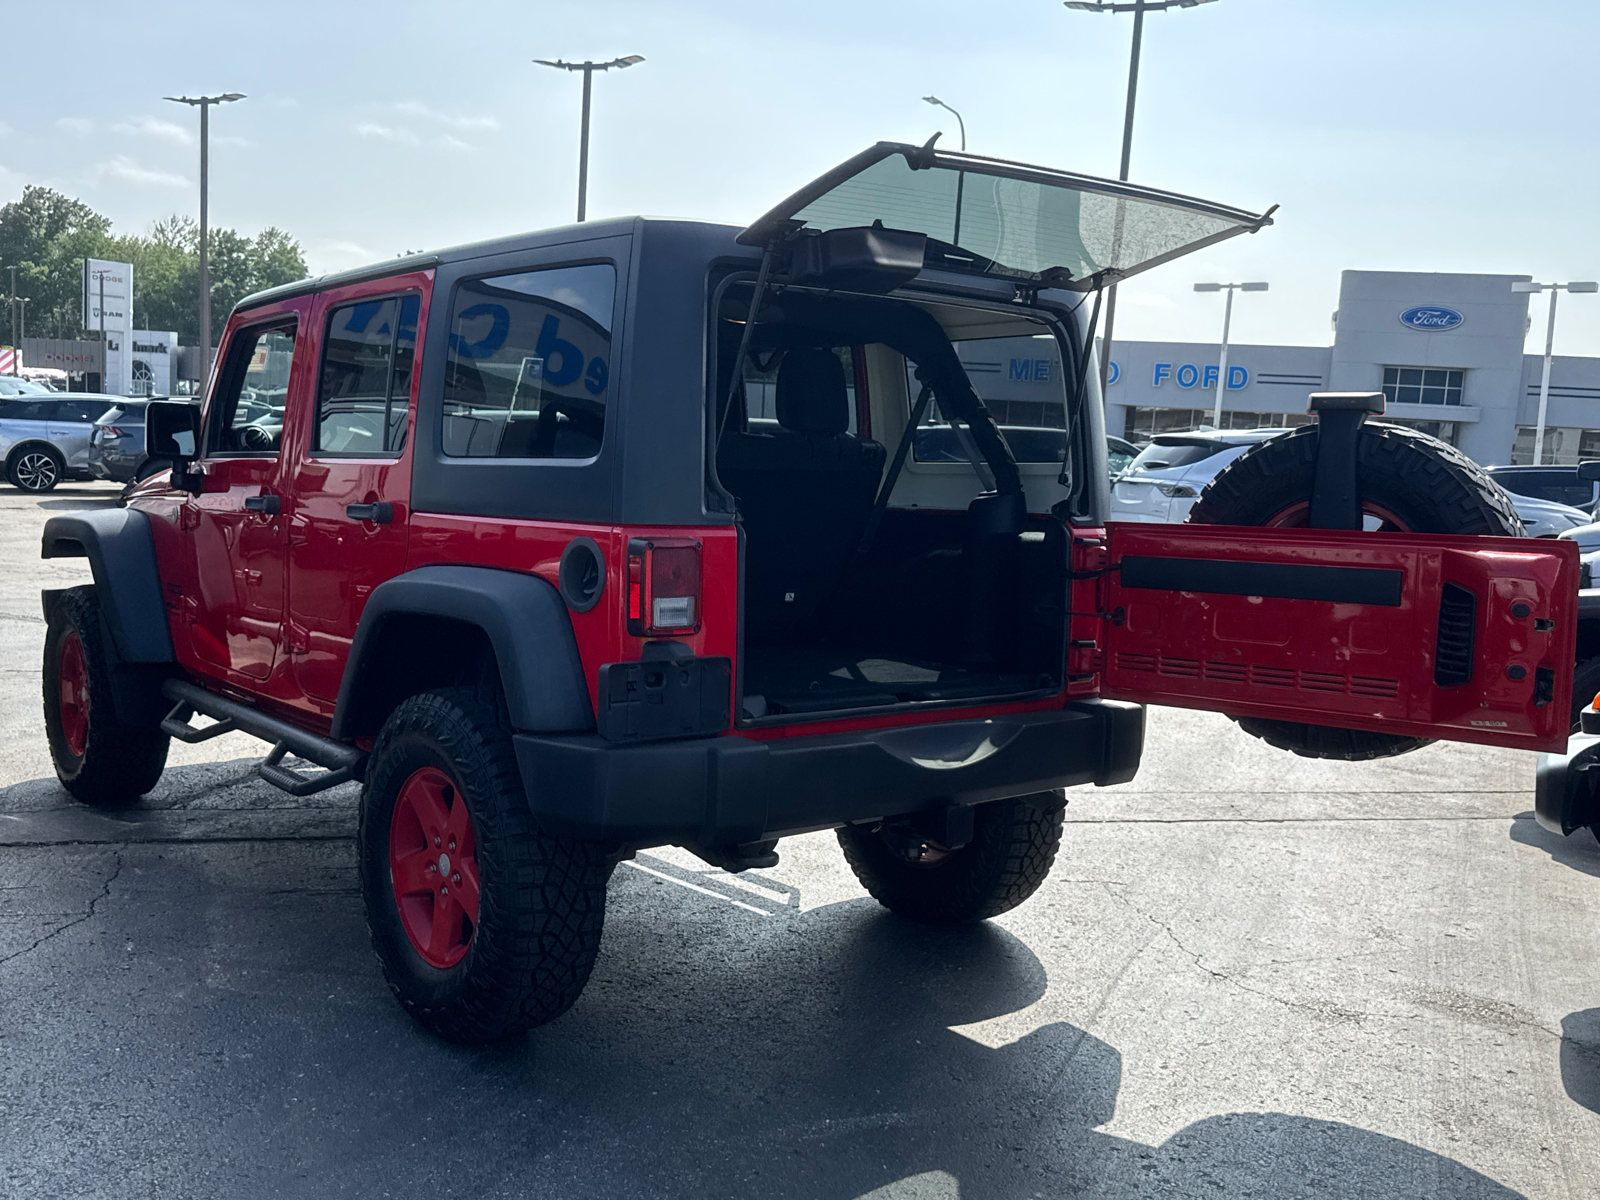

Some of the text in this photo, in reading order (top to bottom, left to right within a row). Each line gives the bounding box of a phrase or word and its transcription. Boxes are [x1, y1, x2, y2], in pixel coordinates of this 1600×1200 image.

[1413, 310, 1450, 325] Ford
[108, 340, 167, 354] Lamark
[1008, 358, 1249, 391] MEO FORD
